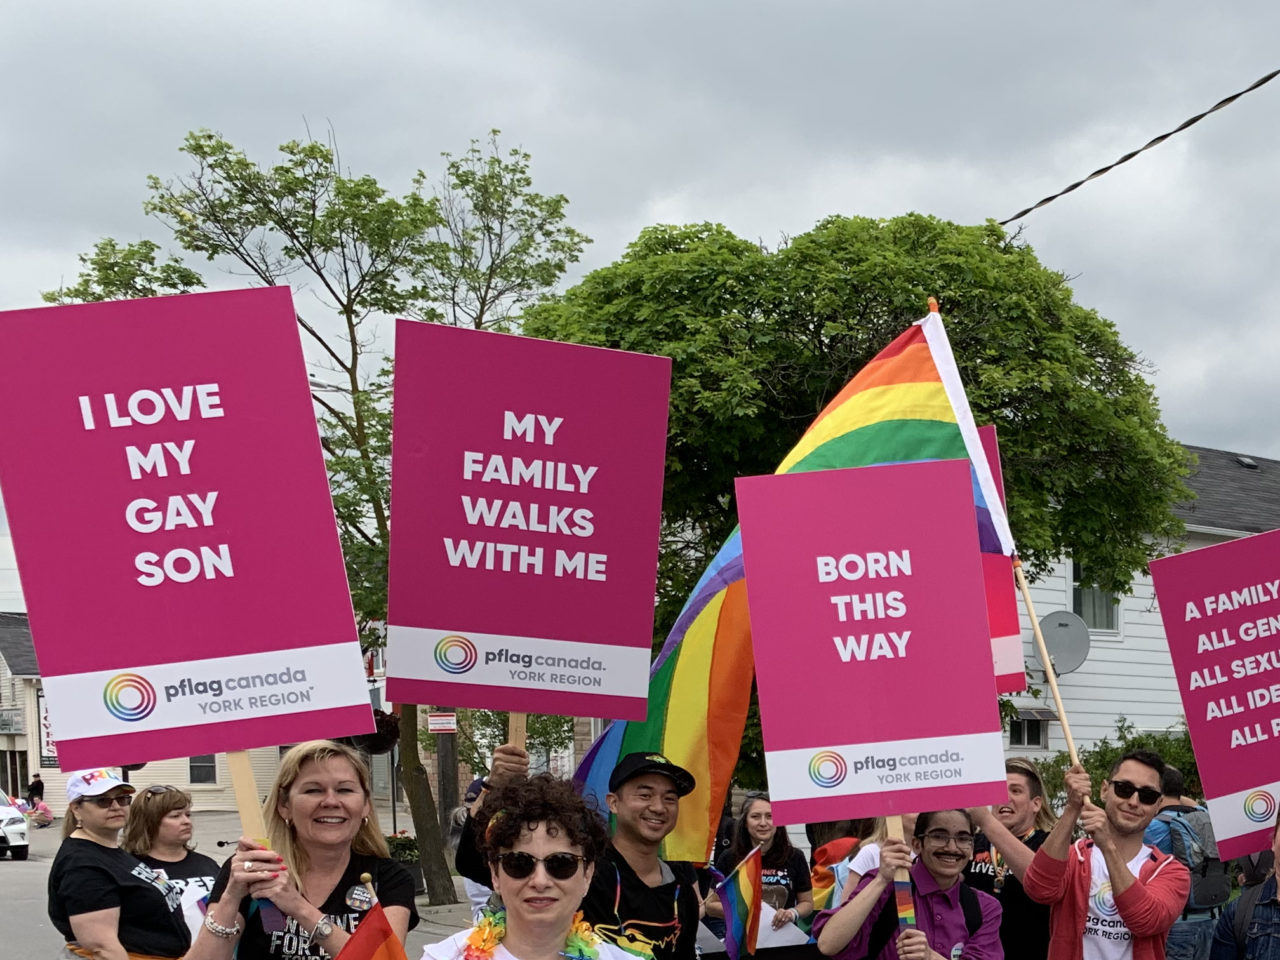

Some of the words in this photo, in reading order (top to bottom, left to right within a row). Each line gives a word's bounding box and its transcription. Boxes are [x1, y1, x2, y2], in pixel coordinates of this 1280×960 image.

[79, 396, 95, 429] I
[104, 384, 224, 427] LOVE
[504, 411, 563, 445] MY
[126, 440, 195, 479] MY
[464, 452, 598, 493] FAMILY
[126, 492, 218, 533] GAY
[462, 496, 594, 536] WALKS
[135, 544, 234, 586] SON
[444, 538, 543, 574] WITH
[555, 550, 607, 581] ME
[817, 550, 912, 582] BORN
[831, 591, 906, 621] THIS
[1186, 602, 1201, 621] A
[1204, 580, 1279, 615] FAMILY
[833, 631, 911, 662] WAY
[1198, 629, 1235, 653] ALL
[509, 670, 546, 683] YORK
[550, 673, 602, 687] REGION
[1190, 666, 1228, 690] ALL
[198, 698, 244, 715] YORK
[248, 690, 311, 709] REGION
[1207, 696, 1244, 720] ALL
[1231, 724, 1268, 748] ALL
[877, 773, 911, 784] YORK
[915, 768, 962, 782] REGION
